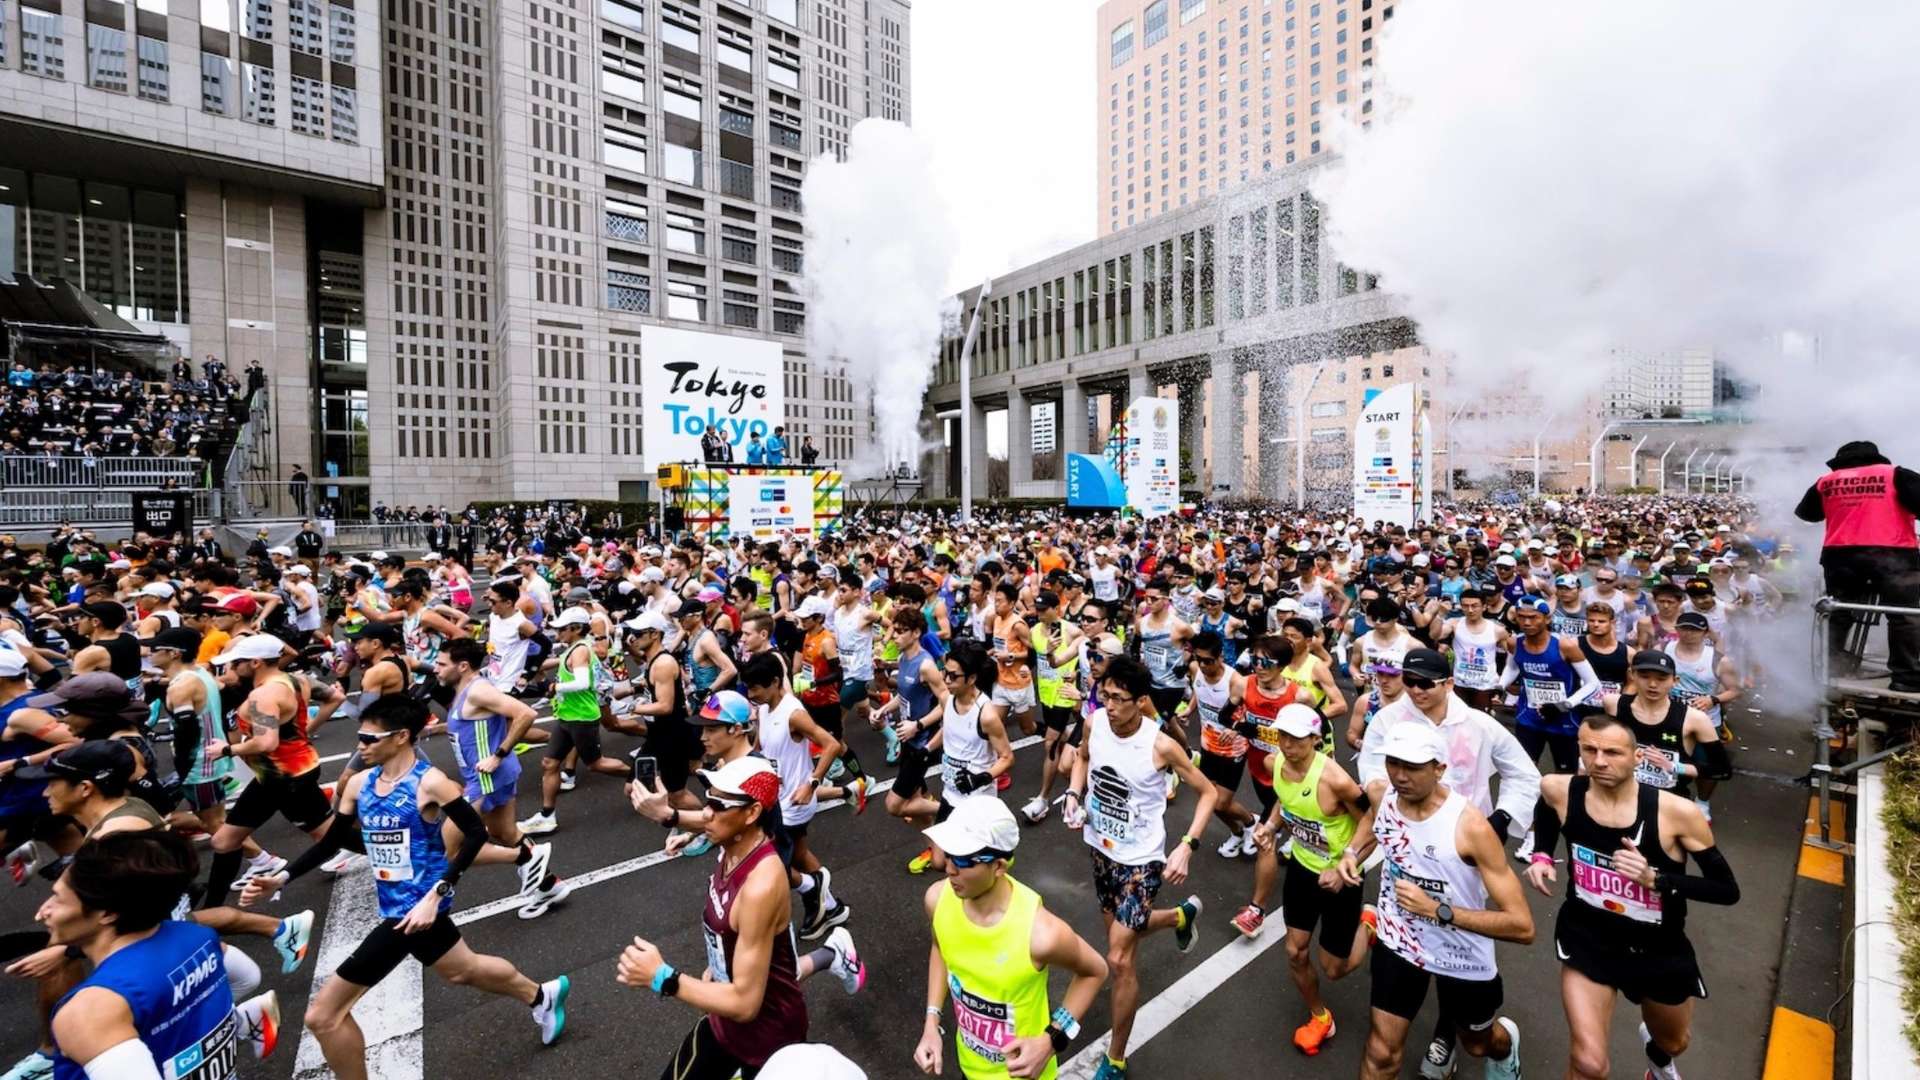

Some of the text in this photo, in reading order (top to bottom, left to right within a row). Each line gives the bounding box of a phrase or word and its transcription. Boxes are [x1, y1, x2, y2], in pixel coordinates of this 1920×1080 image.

[663, 361, 768, 414] Tokyo
[663, 403, 768, 446] Tokyo
[1366, 411, 1400, 423] START
[1070, 459, 1080, 499] START
[146, 511, 171, 520] 出口
[1591, 868, 1644, 902] 10061
[172, 952, 218, 1007] KPMG
[956, 1004, 1005, 1047] 20774
